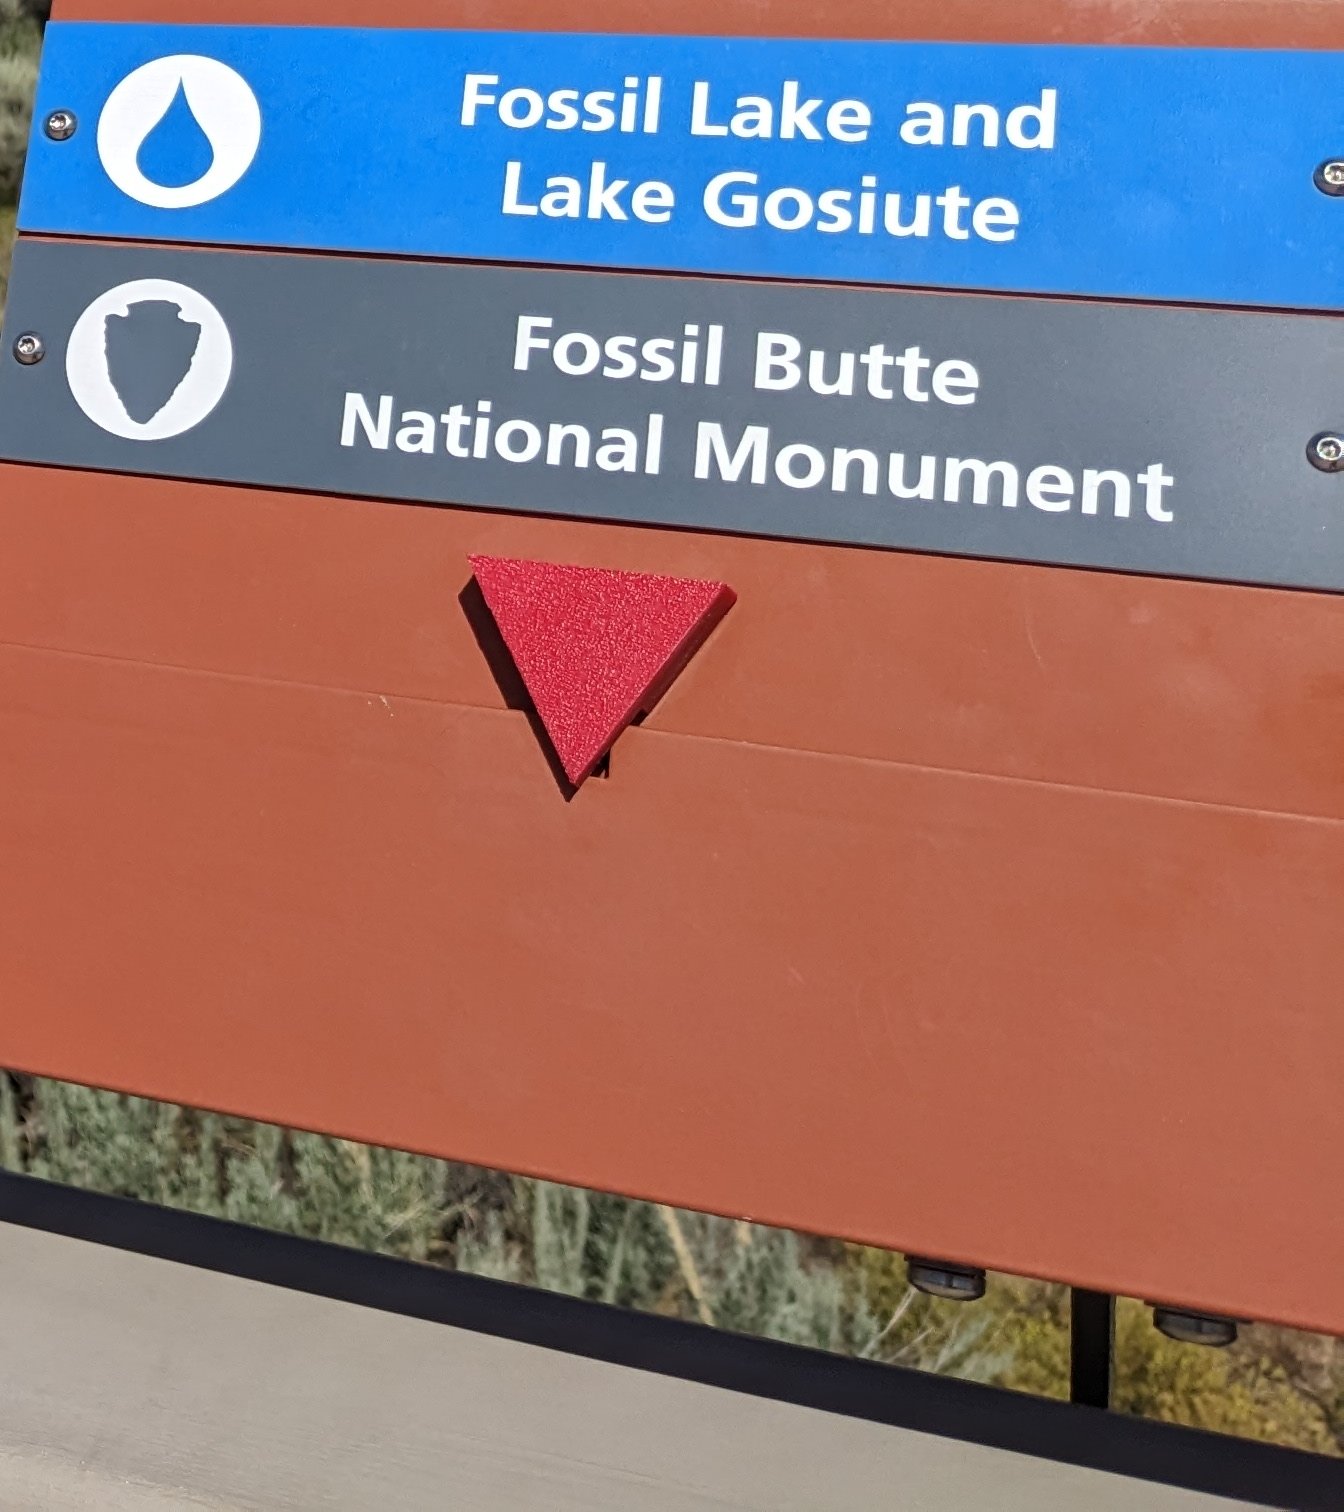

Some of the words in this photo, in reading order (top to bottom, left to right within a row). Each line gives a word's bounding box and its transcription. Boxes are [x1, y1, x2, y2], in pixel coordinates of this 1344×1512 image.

[461, 74, 661, 133] Fossil
[691, 81, 871, 142] Lake
[900, 89, 1056, 148] and
[503, 162, 674, 222] Lake
[704, 172, 1019, 241] Gosiute
[514, 315, 724, 385] Fossil
[755, 332, 980, 405] Butte
[341, 392, 664, 474] National
[694, 421, 1175, 522] Monument
